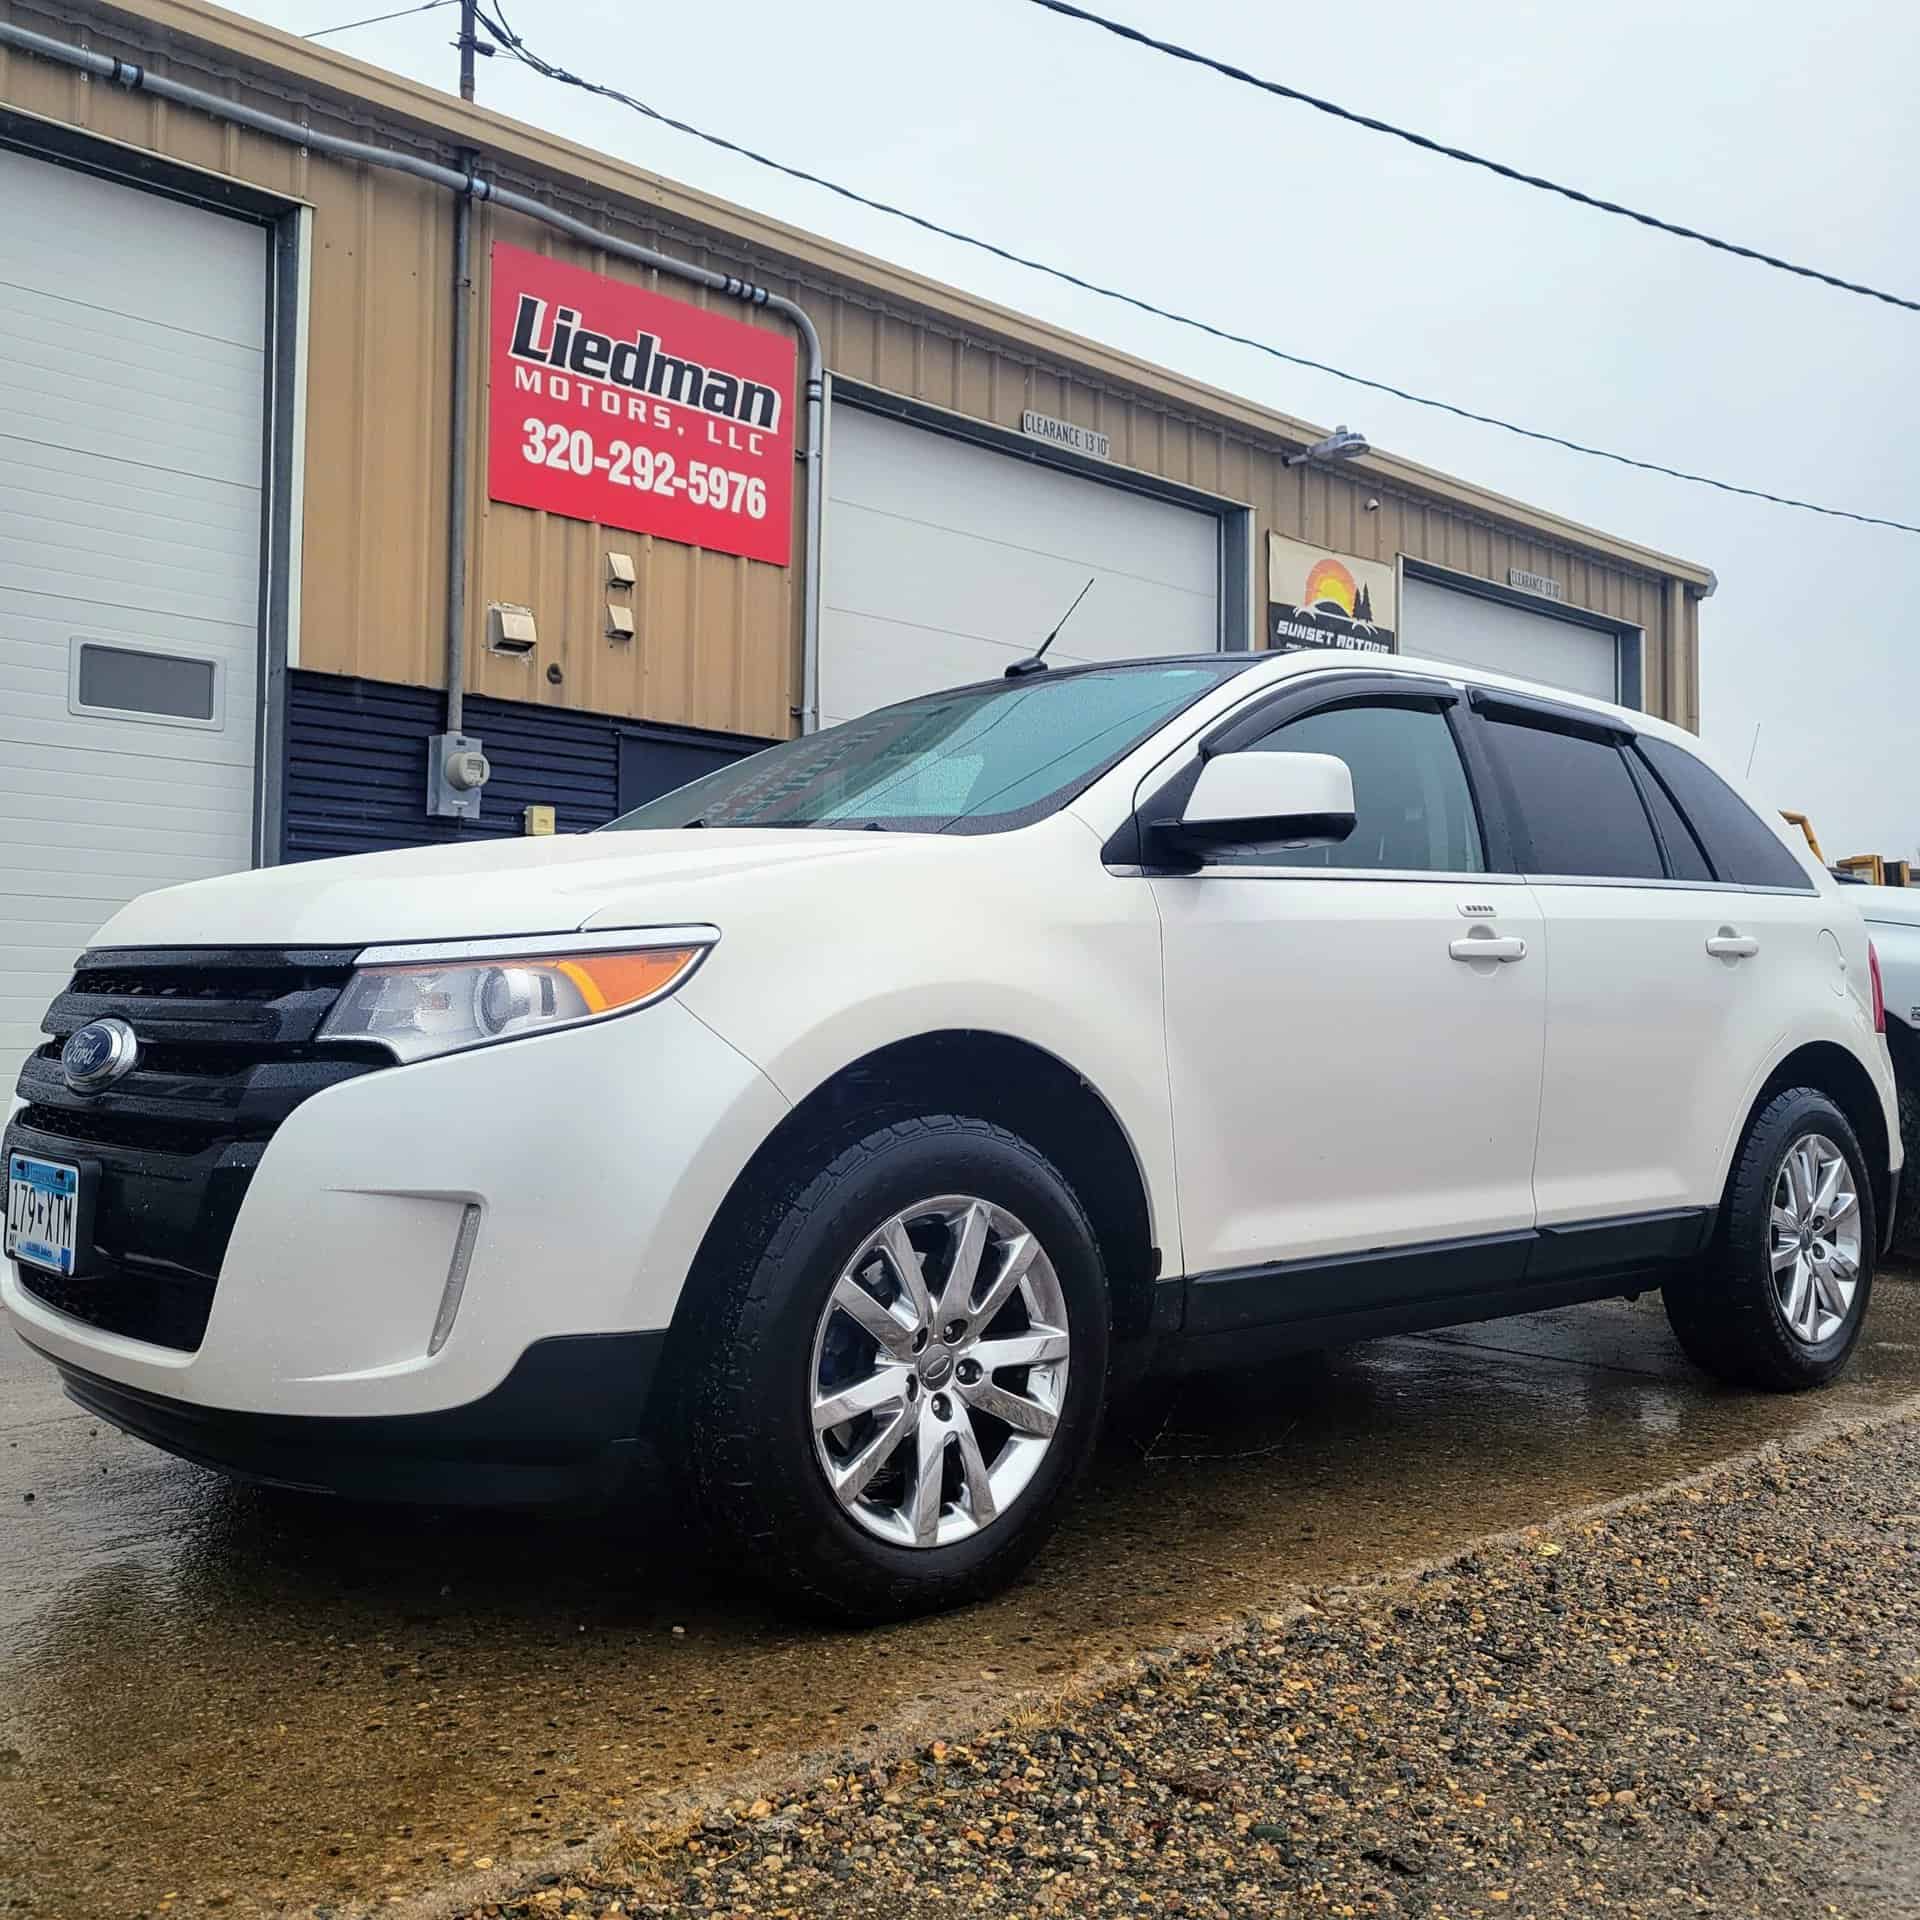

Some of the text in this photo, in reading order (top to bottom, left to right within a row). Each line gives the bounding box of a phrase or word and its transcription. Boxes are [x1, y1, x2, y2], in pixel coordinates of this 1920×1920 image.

[509, 293, 781, 434] Liedman
[515, 366, 763, 456] MOTORS, LLC
[1025, 413, 1080, 447] CLEARANCE
[522, 418, 767, 519] 320-292-5976
[1276, 620, 1334, 645] SUNSET
[66, 1031, 102, 1064] Ford
[10, 1182, 73, 1249] 179 XTM
